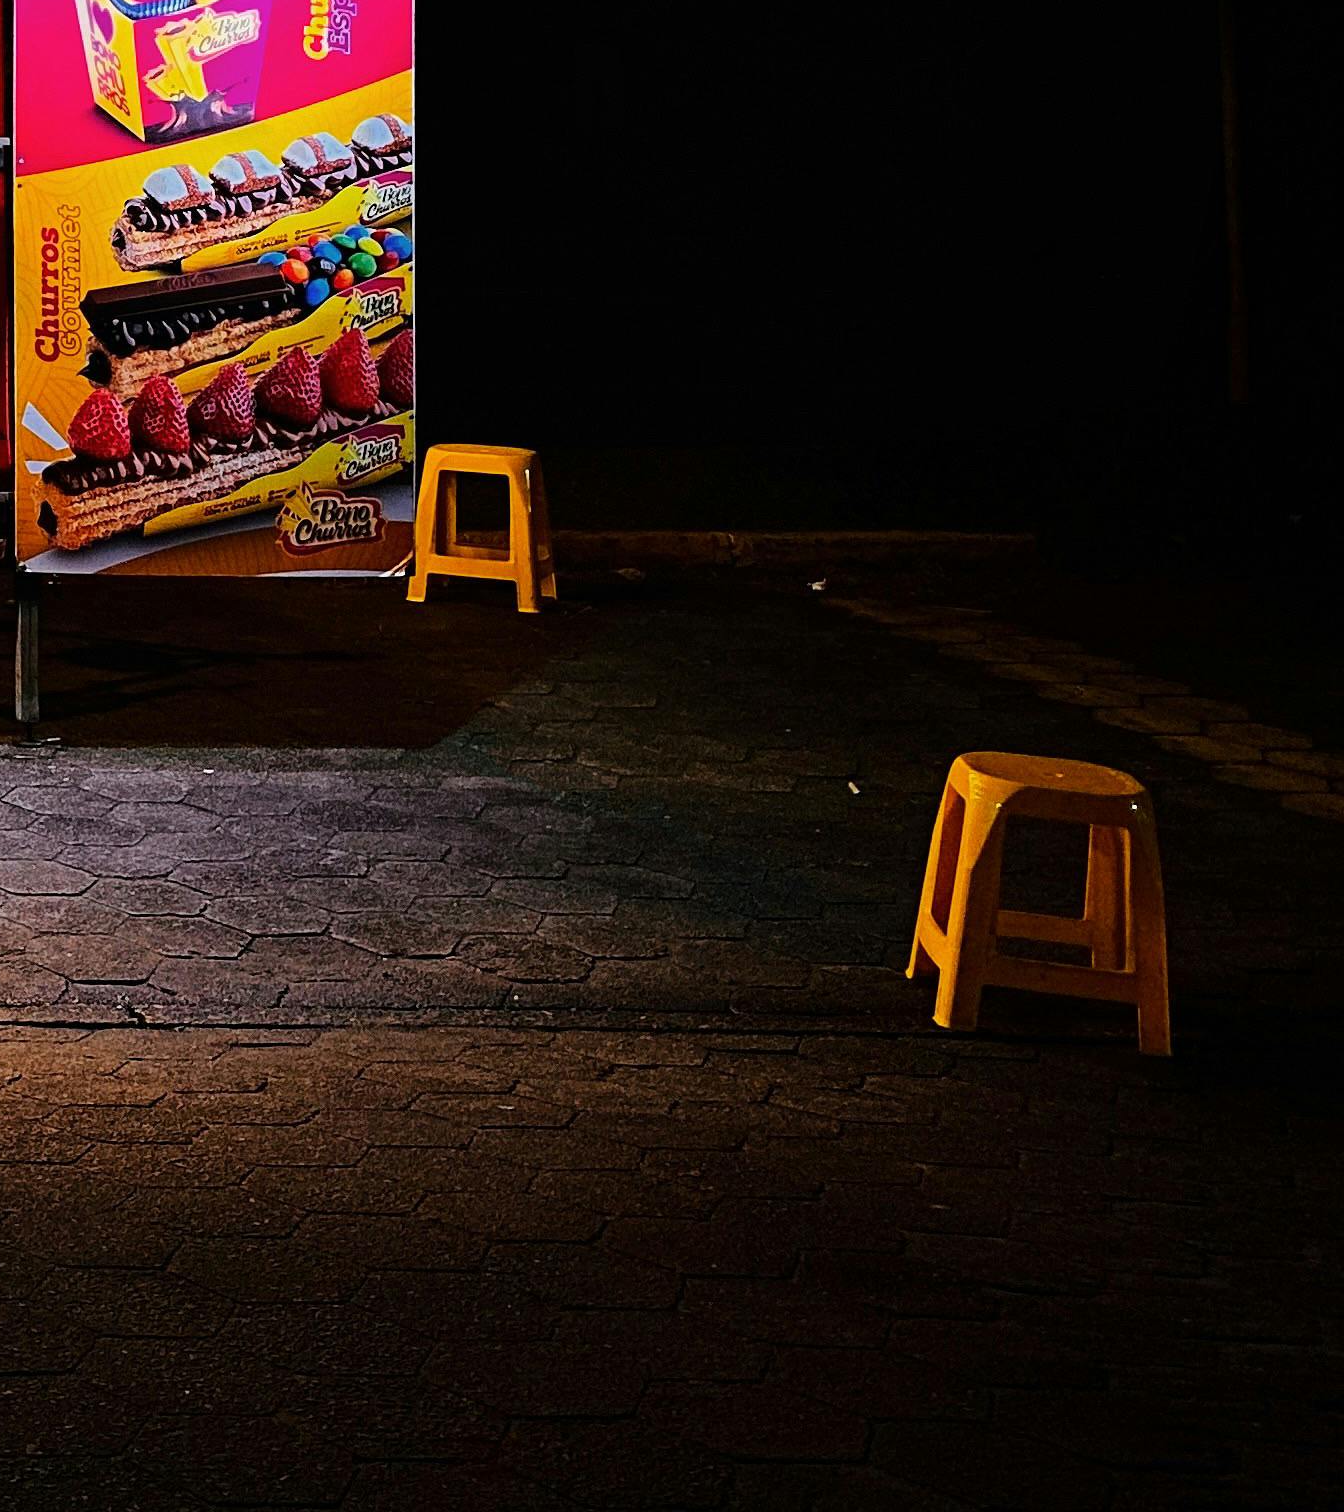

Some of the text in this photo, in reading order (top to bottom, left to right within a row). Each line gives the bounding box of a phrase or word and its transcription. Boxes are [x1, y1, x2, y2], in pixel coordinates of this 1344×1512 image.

[35, 227, 59, 362] Churros
[57, 204, 82, 356] Gourmet
[295, 519, 372, 545] Churros
[310, 499, 371, 524] Bono
